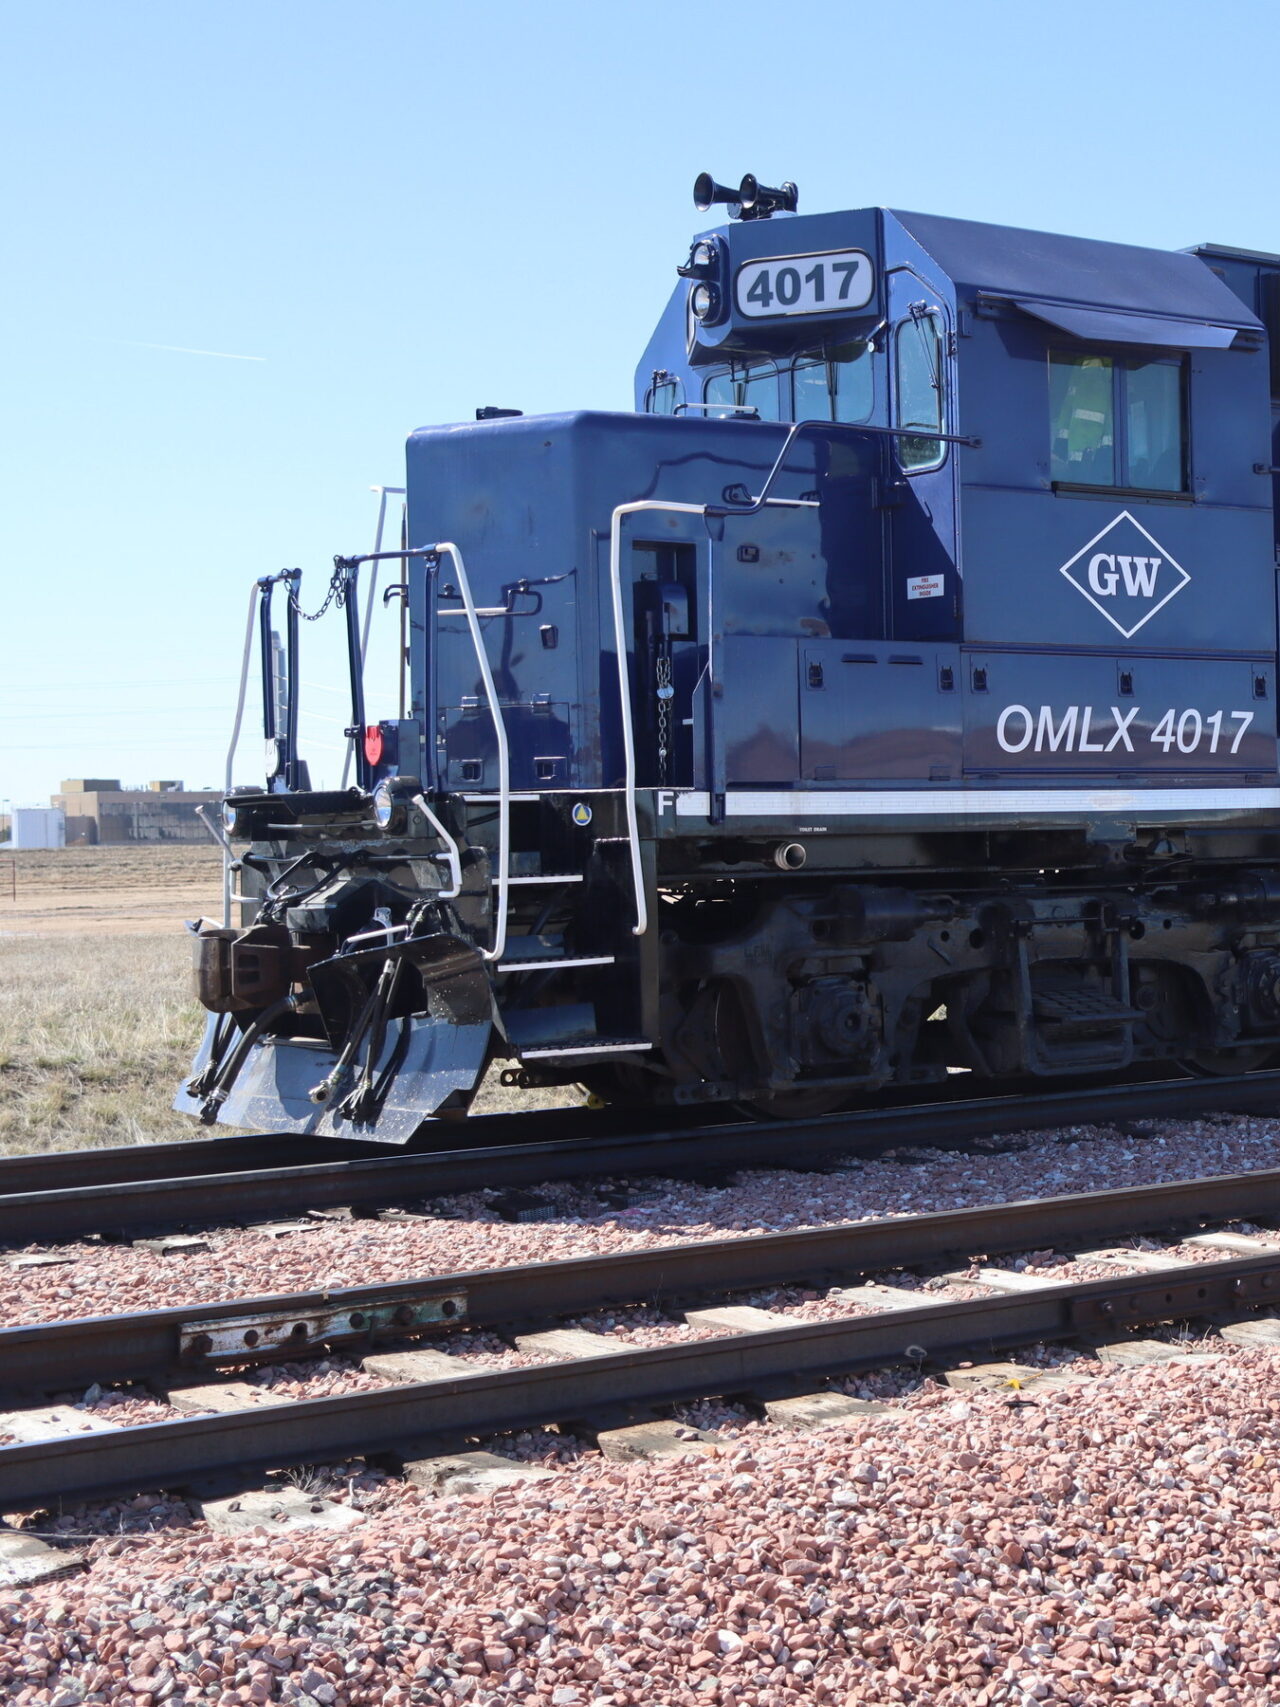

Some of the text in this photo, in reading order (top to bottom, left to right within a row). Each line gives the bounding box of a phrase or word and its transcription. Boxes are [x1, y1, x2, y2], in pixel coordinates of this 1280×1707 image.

[747, 261, 859, 308] 4017
[1088, 553, 1162, 597] GW
[996, 704, 1254, 754] OMLX 4017
[658, 791, 674, 816] F
